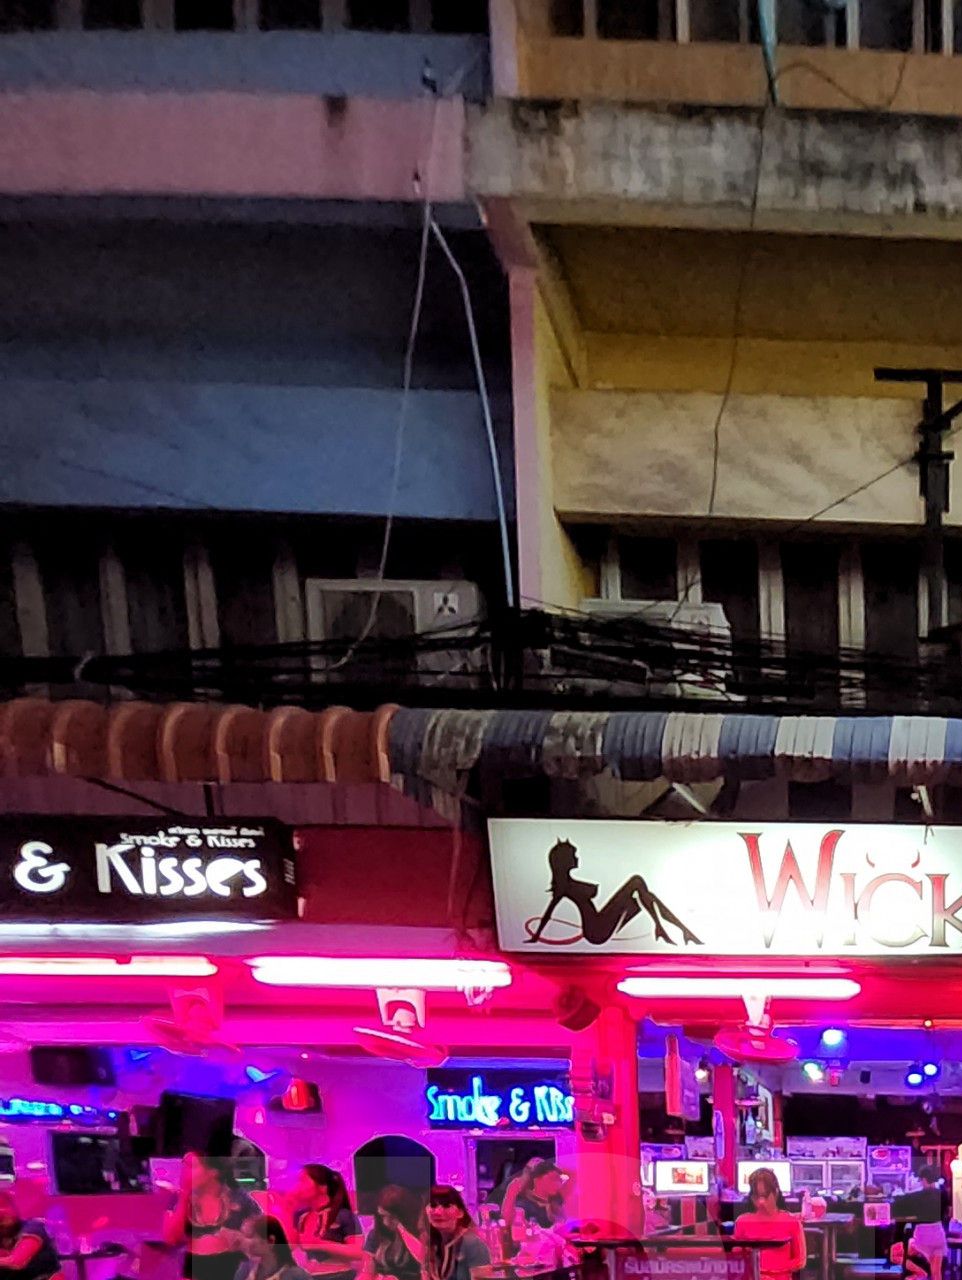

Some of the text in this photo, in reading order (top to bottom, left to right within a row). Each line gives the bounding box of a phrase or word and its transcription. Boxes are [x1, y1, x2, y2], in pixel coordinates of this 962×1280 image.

[120, 831, 181, 848] Smoke
[186, 836, 203, 848] &
[207, 836, 256, 848] Kisses
[13, 840, 70, 893] &
[95, 842, 267, 898] Kisses
[509, 1088, 531, 1123] &
